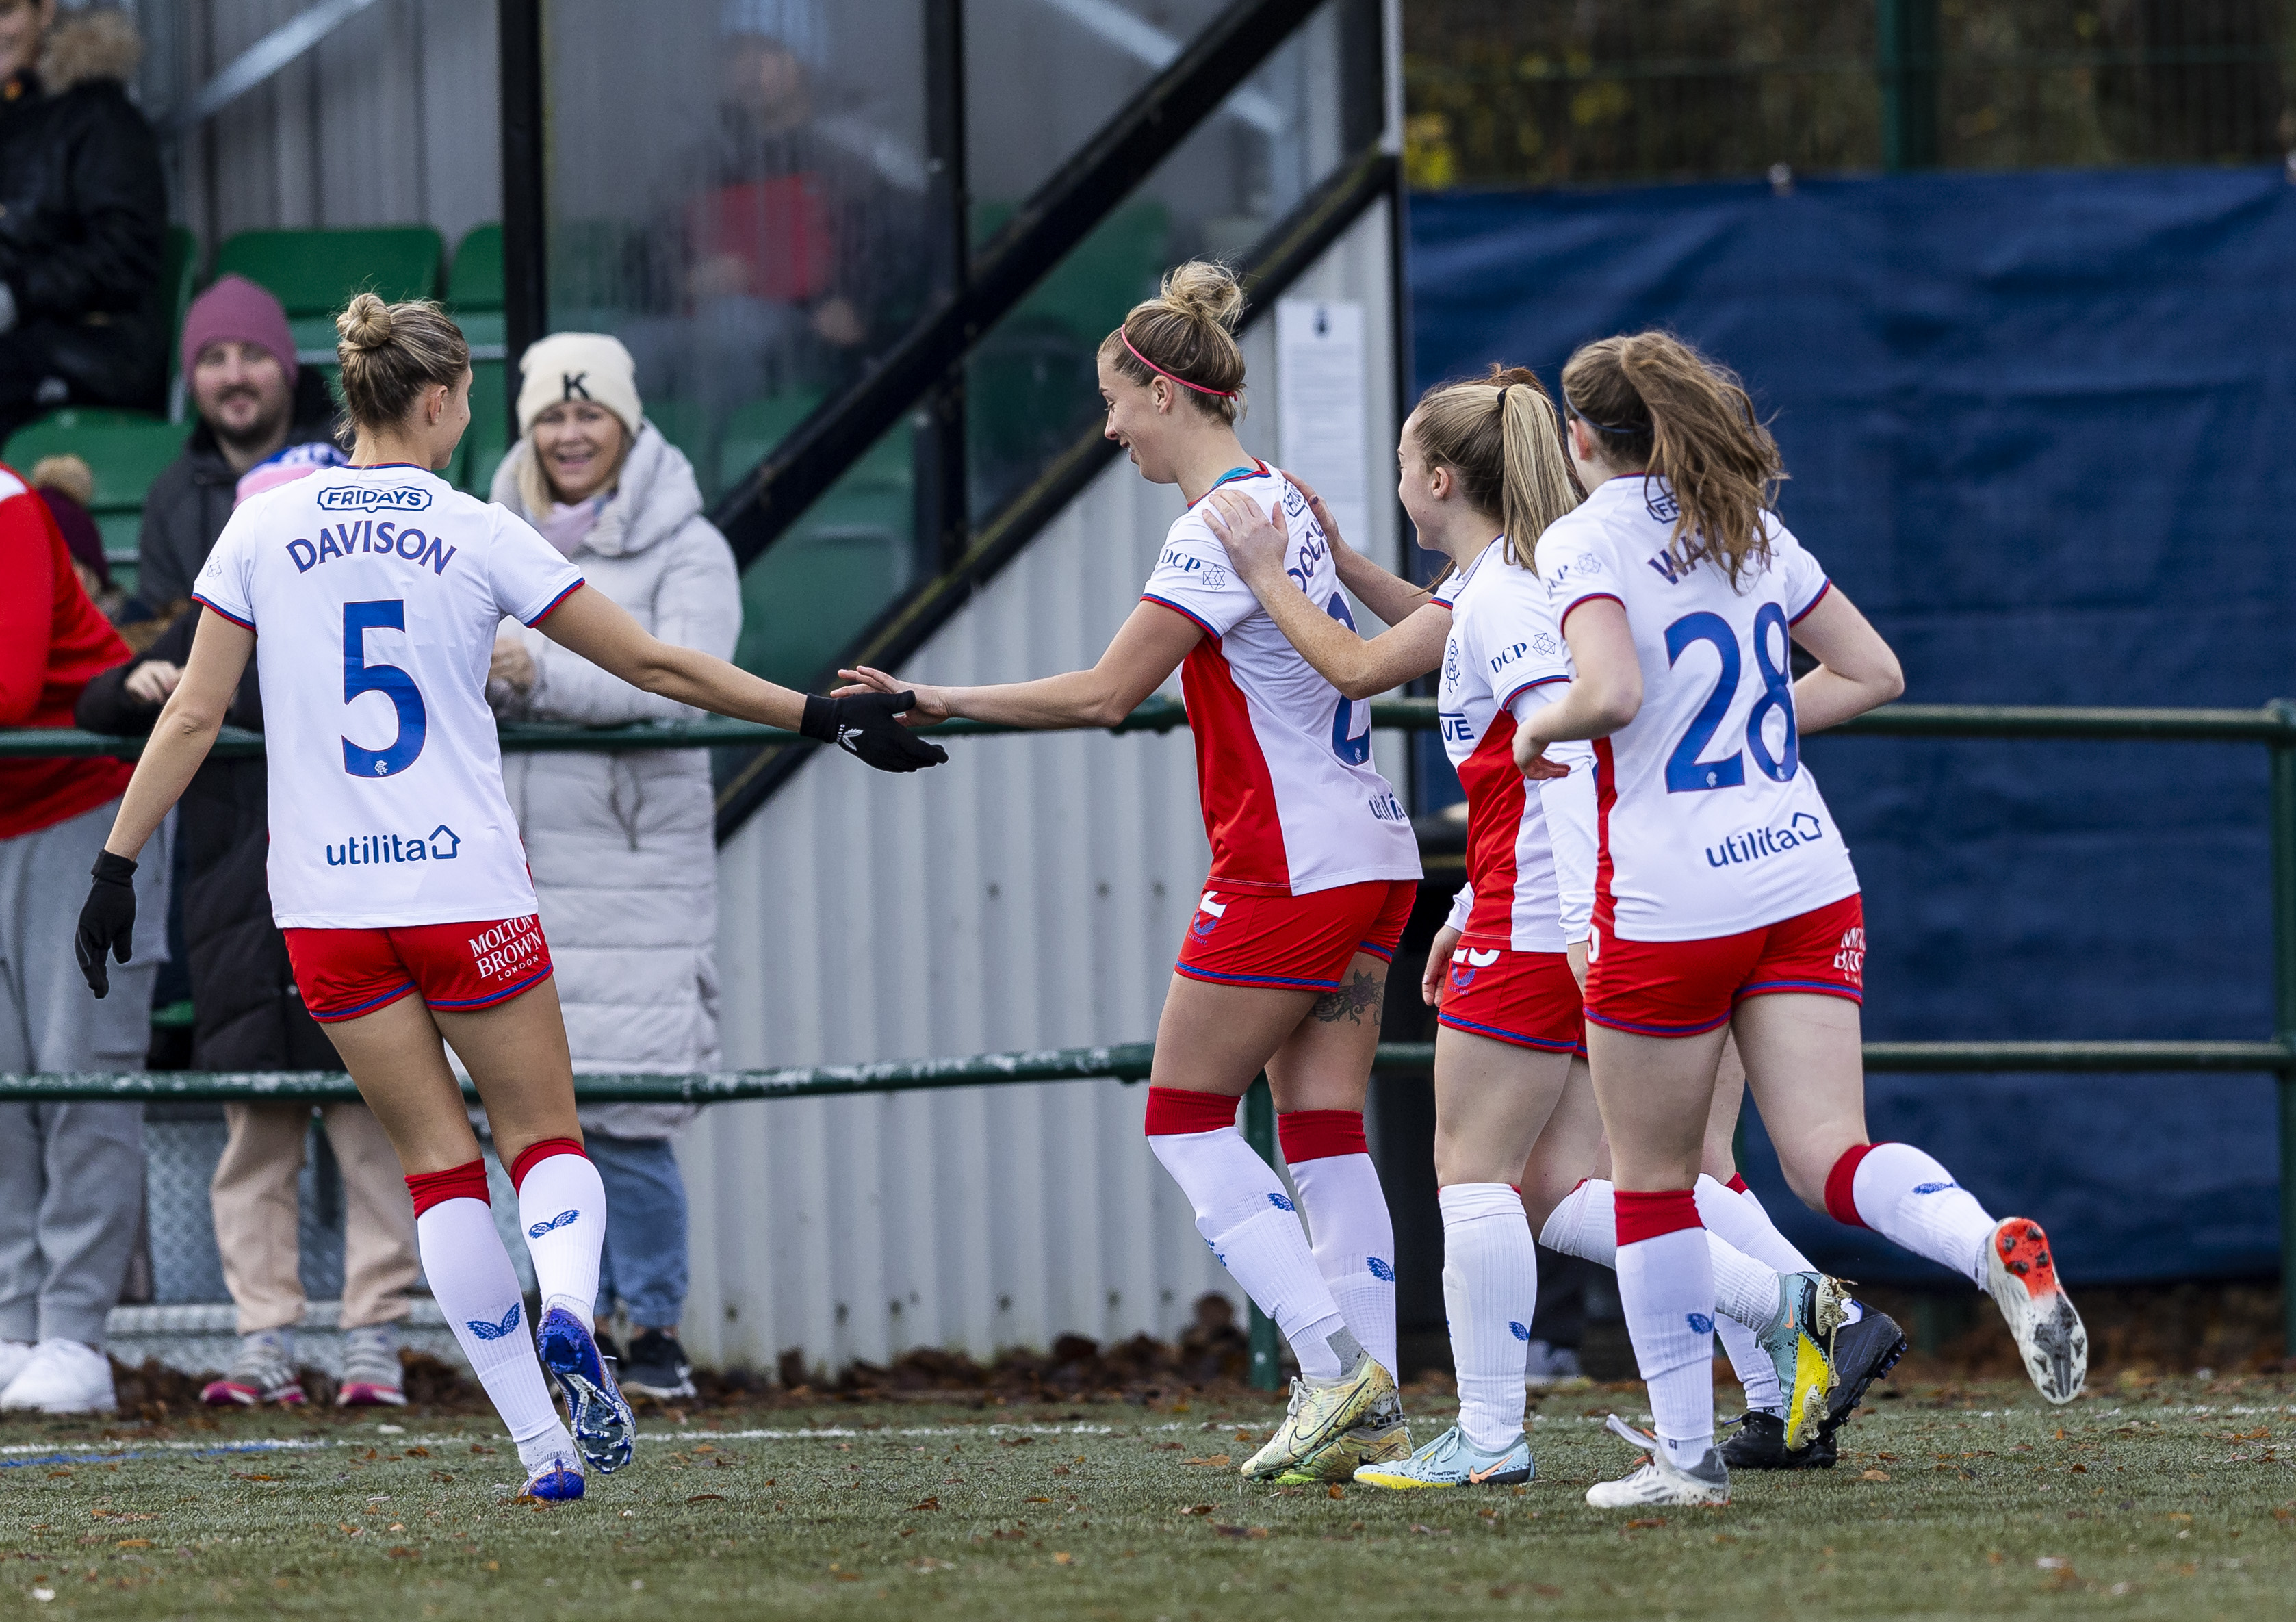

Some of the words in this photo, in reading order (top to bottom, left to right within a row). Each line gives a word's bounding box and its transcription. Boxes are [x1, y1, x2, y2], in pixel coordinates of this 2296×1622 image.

[563, 371, 591, 402] K
[327, 490, 422, 506] FRIDAYS
[285, 520, 456, 576] DAVISON
[1161, 549, 1201, 572] DCP
[1490, 643, 1527, 674] DCP
[341, 599, 427, 777] 5
[1664, 602, 1799, 794] 28
[326, 834, 428, 866] utilita
[1705, 827, 1801, 868] utilita
[468, 915, 534, 958] MOLTON
[476, 927, 543, 979] BROWN
[498, 954, 539, 981] LONDON
